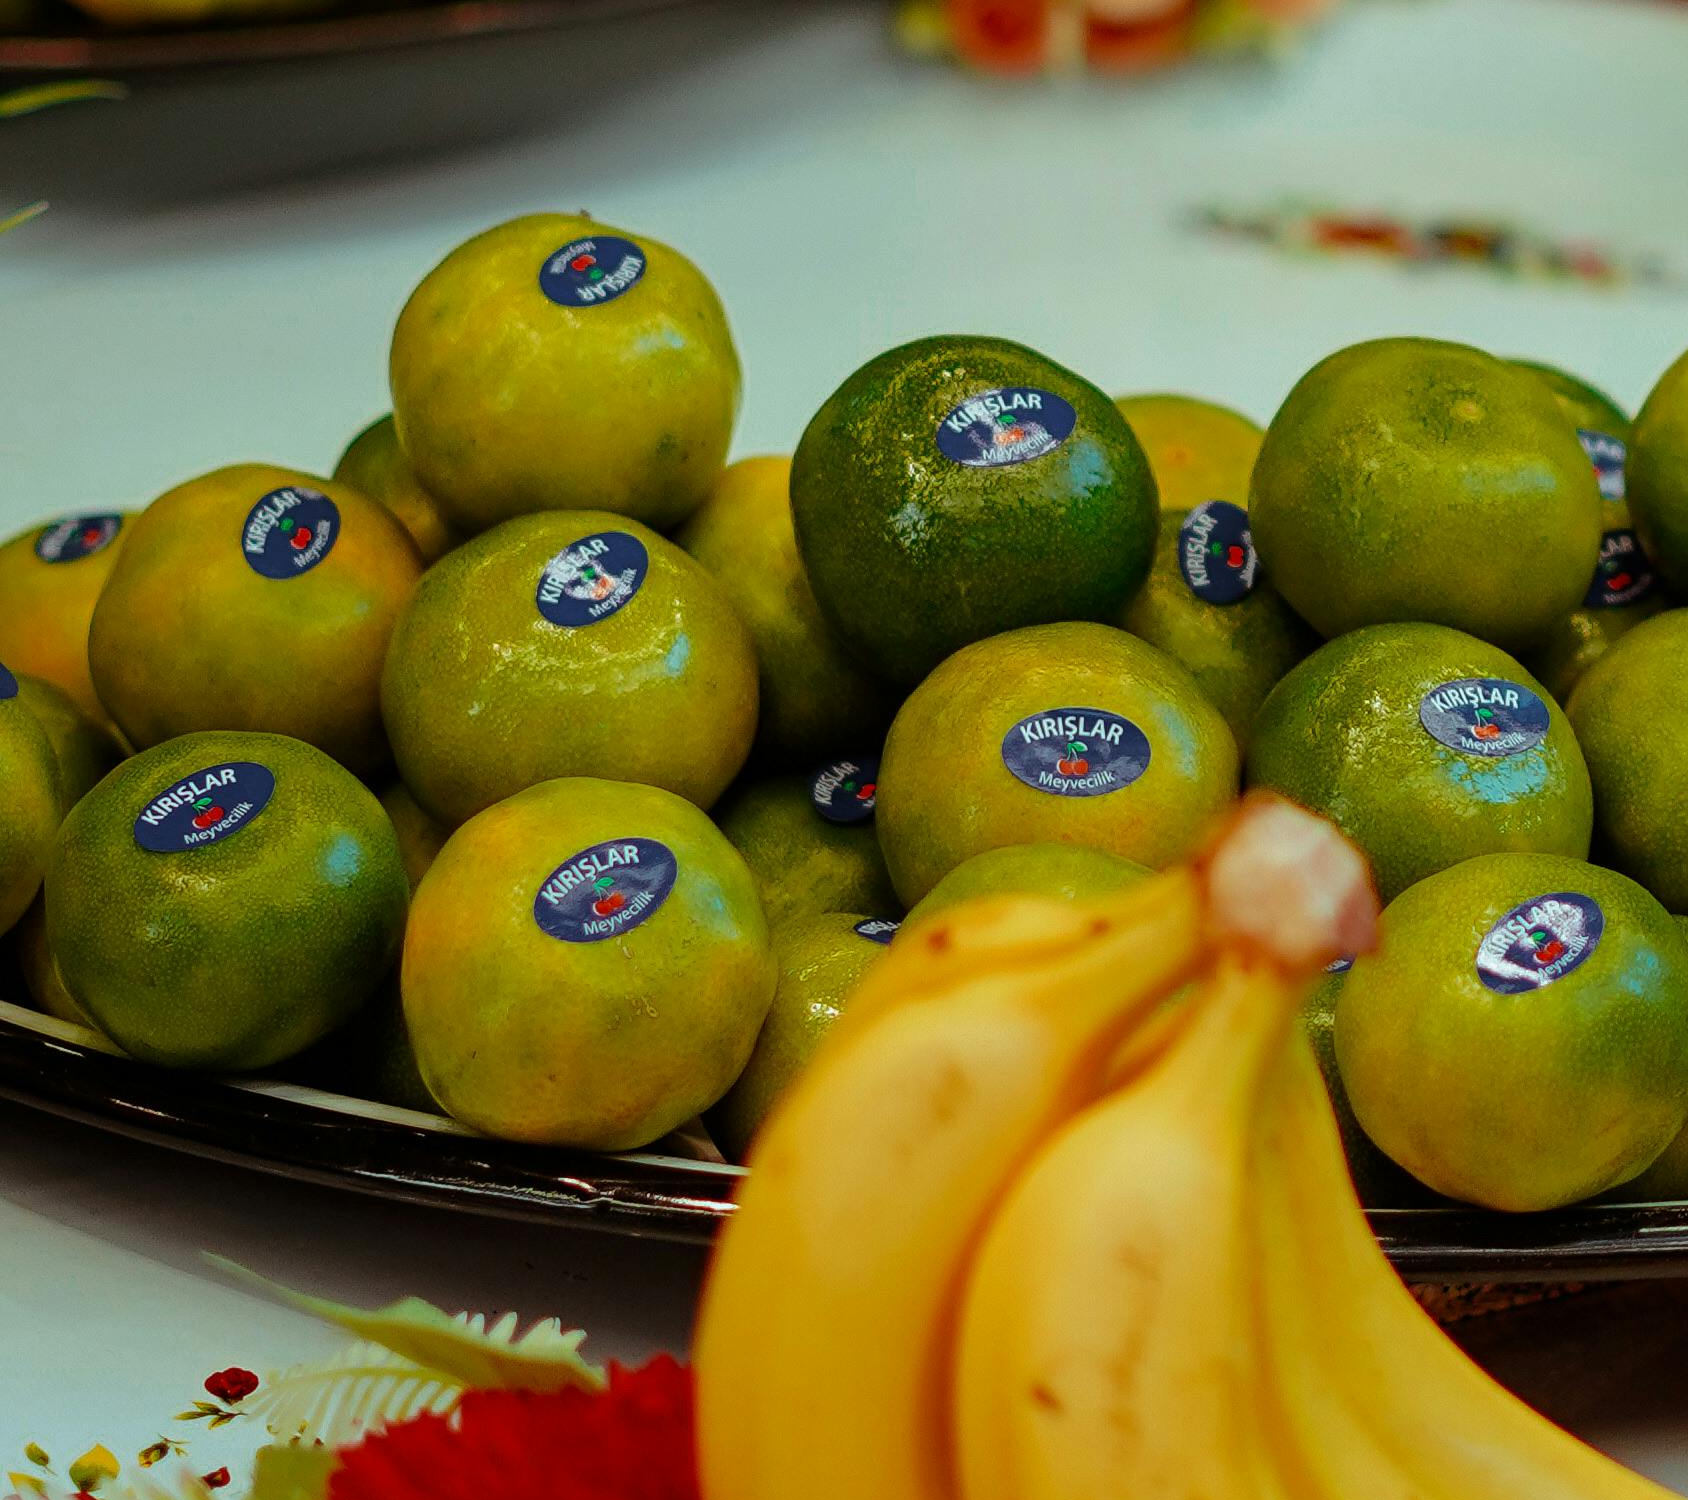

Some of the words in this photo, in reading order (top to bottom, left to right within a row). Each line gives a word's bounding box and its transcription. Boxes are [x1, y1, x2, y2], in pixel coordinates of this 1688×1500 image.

[946, 393, 1042, 433] KIRIŞLAR
[981, 430, 1053, 463] Meyvecilik
[246, 489, 301, 553] KIRIŞLAR
[540, 538, 608, 604] KIRIŞLAR
[1187, 512, 1218, 587] KIRIŞLAR
[1430, 688, 1519, 713] KIRIŞLAR
[1020, 715, 1124, 745] KIRIŞLAR
[1460, 731, 1525, 753] Meyvecilik
[140, 766, 237, 827] KIRIŞLAR
[814, 762, 860, 806] KIRIŞLAR
[1038, 768, 1115, 793] Meyvecilik
[183, 800, 254, 845] Meyvecilik
[541, 842, 641, 905] KIRIŞLAR
[583, 890, 656, 937] Meyvecilik
